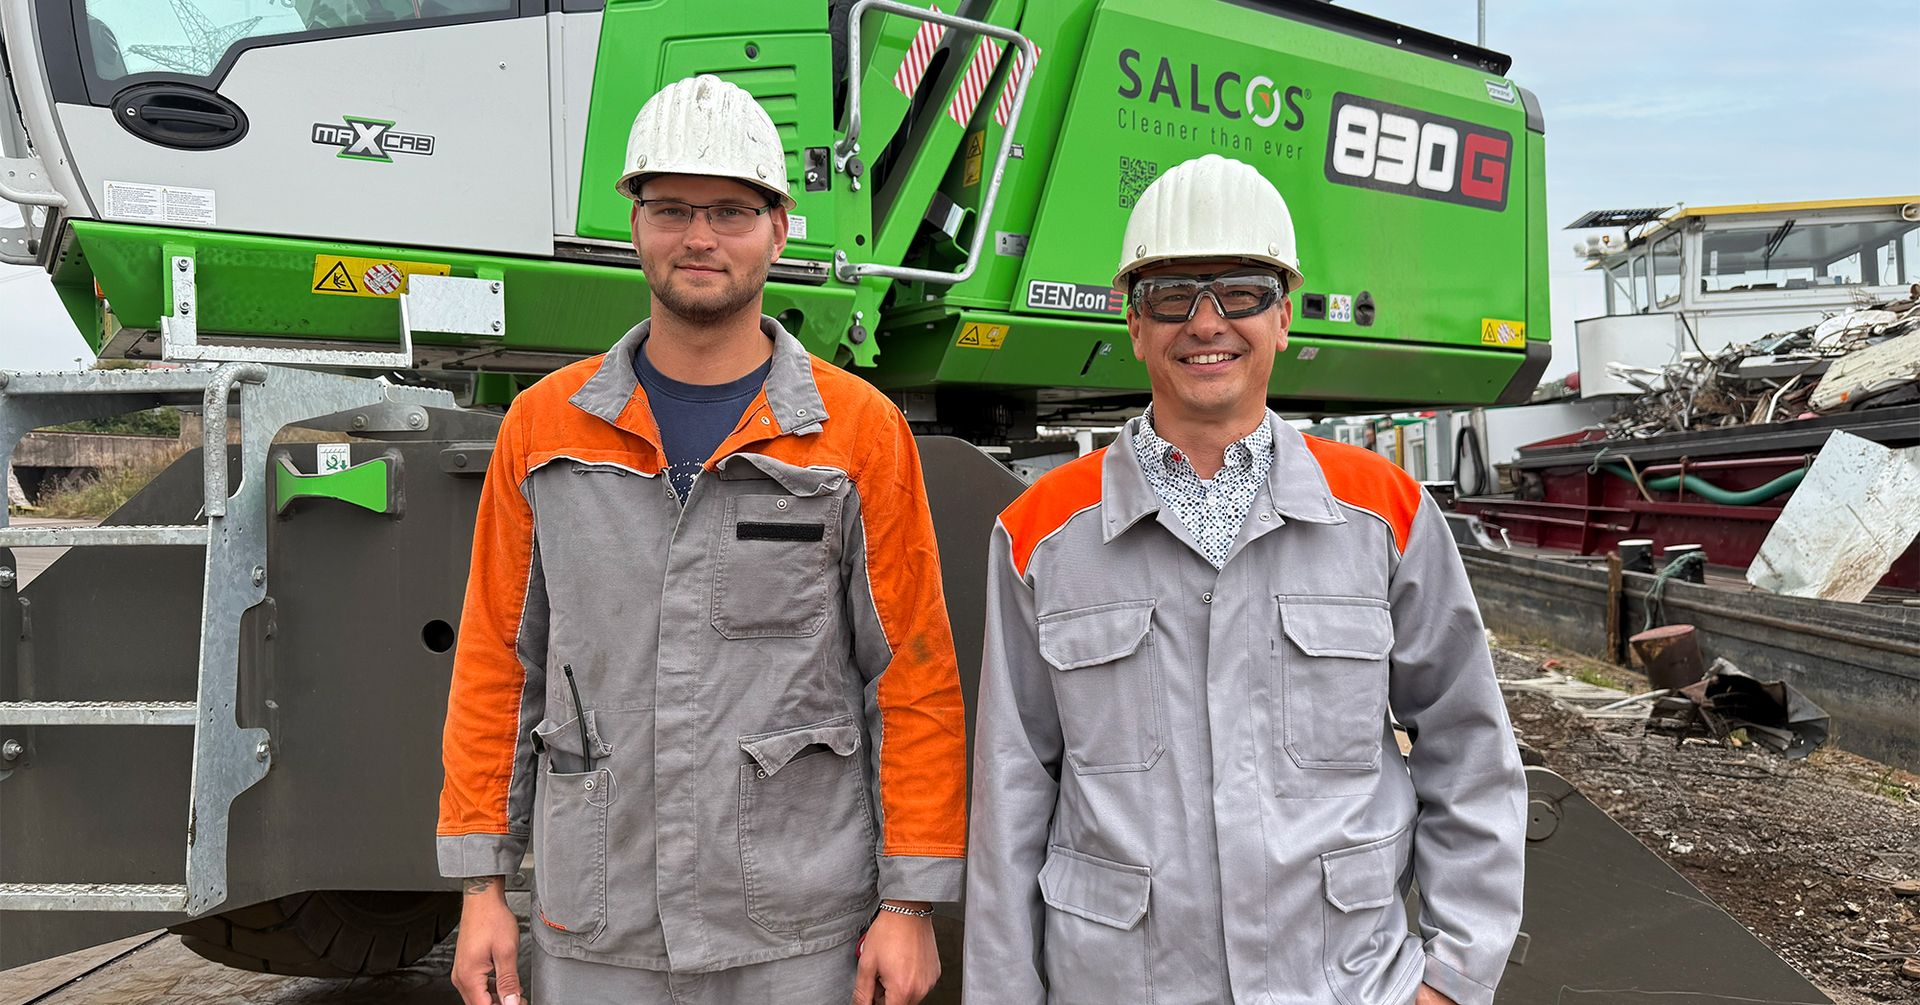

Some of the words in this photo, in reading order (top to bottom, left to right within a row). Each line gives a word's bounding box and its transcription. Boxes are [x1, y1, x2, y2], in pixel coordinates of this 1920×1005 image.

[1118, 108, 1198, 141] Cleaner
[1211, 126, 1251, 151] than
[1264, 140, 1303, 160] ever
